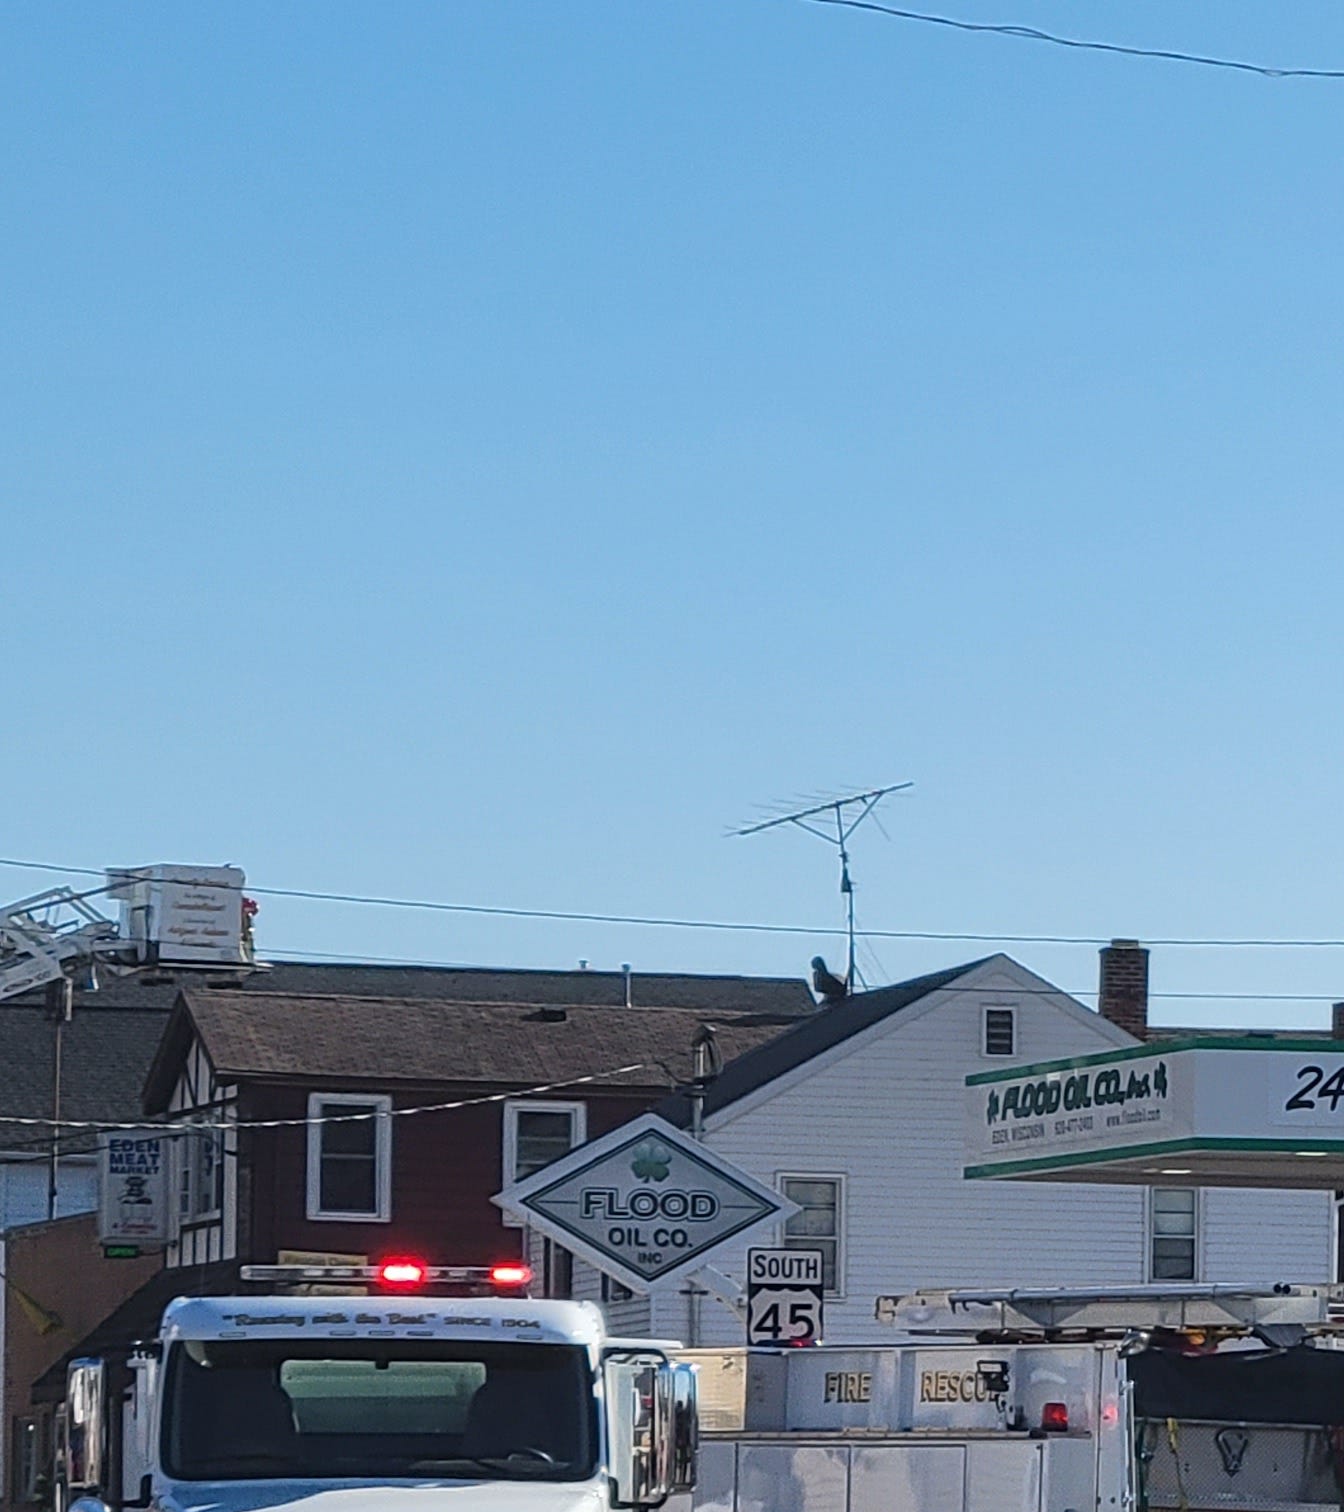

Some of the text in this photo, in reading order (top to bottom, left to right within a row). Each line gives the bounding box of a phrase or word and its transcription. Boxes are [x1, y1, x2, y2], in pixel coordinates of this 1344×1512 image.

[1001, 1080, 1061, 1120] FLOOD
[1064, 1074, 1092, 1111] OIL
[109, 1139, 160, 1152] EDEN
[109, 1153, 160, 1165] MEAT
[109, 1165, 160, 1174] MARKET
[581, 1188, 719, 1221] FLOOD
[608, 1227, 693, 1248] OIL CO.
[638, 1252, 662, 1264] INC
[752, 1254, 818, 1279] SOUTH
[753, 1302, 815, 1340] 45
[824, 1371, 873, 1403] FIRE
